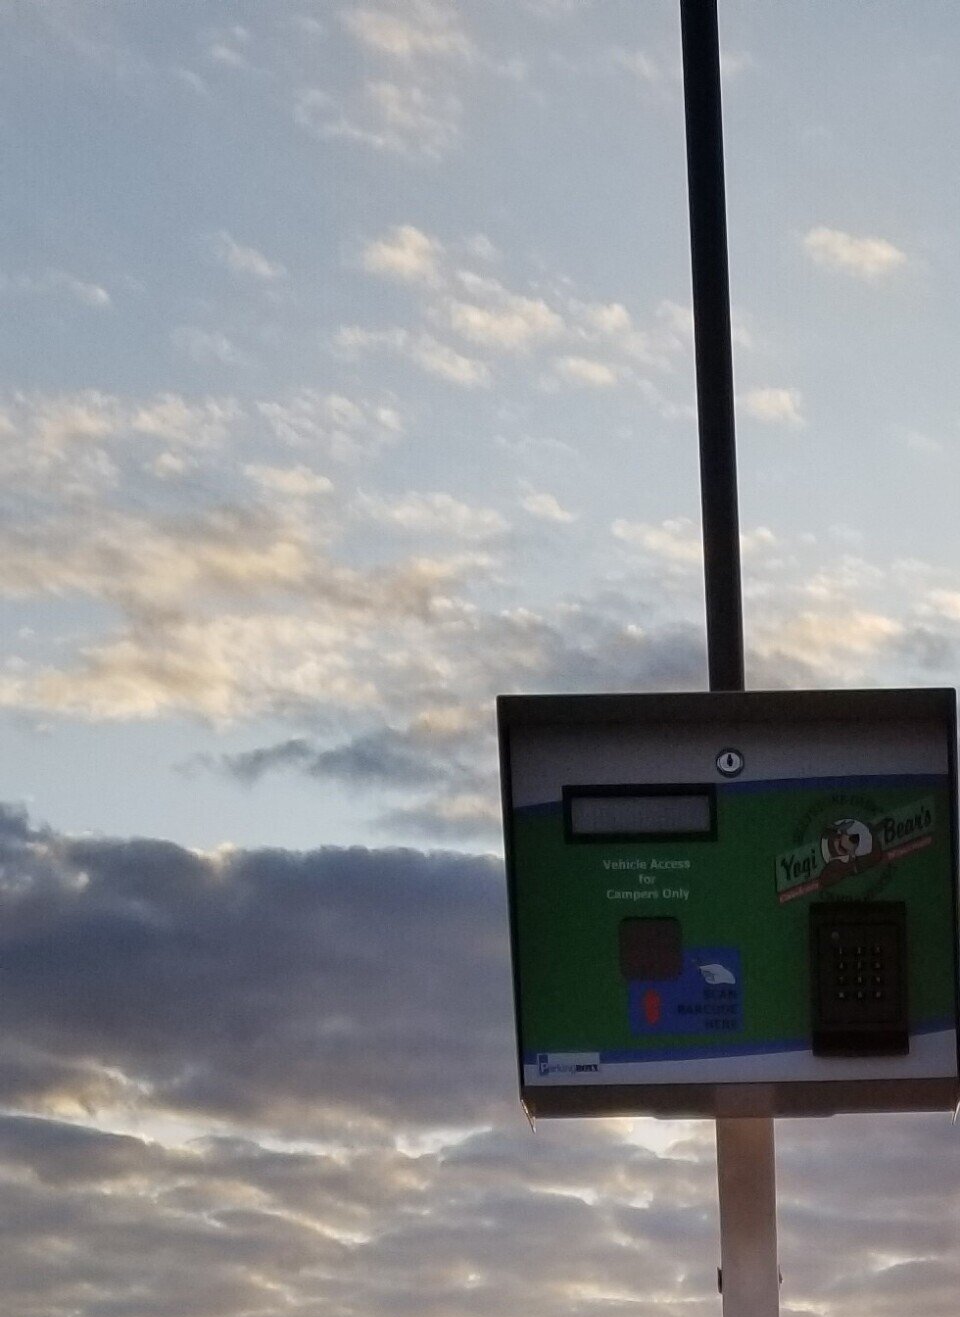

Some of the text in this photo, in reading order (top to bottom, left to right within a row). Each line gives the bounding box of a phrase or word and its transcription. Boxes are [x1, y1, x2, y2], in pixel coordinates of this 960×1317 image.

[781, 850, 817, 880] Yogi
[883, 806, 932, 842] Bear's
[603, 858, 691, 870] Vehicle Access
[639, 873, 656, 885] for
[606, 887, 690, 901] Campers Only
